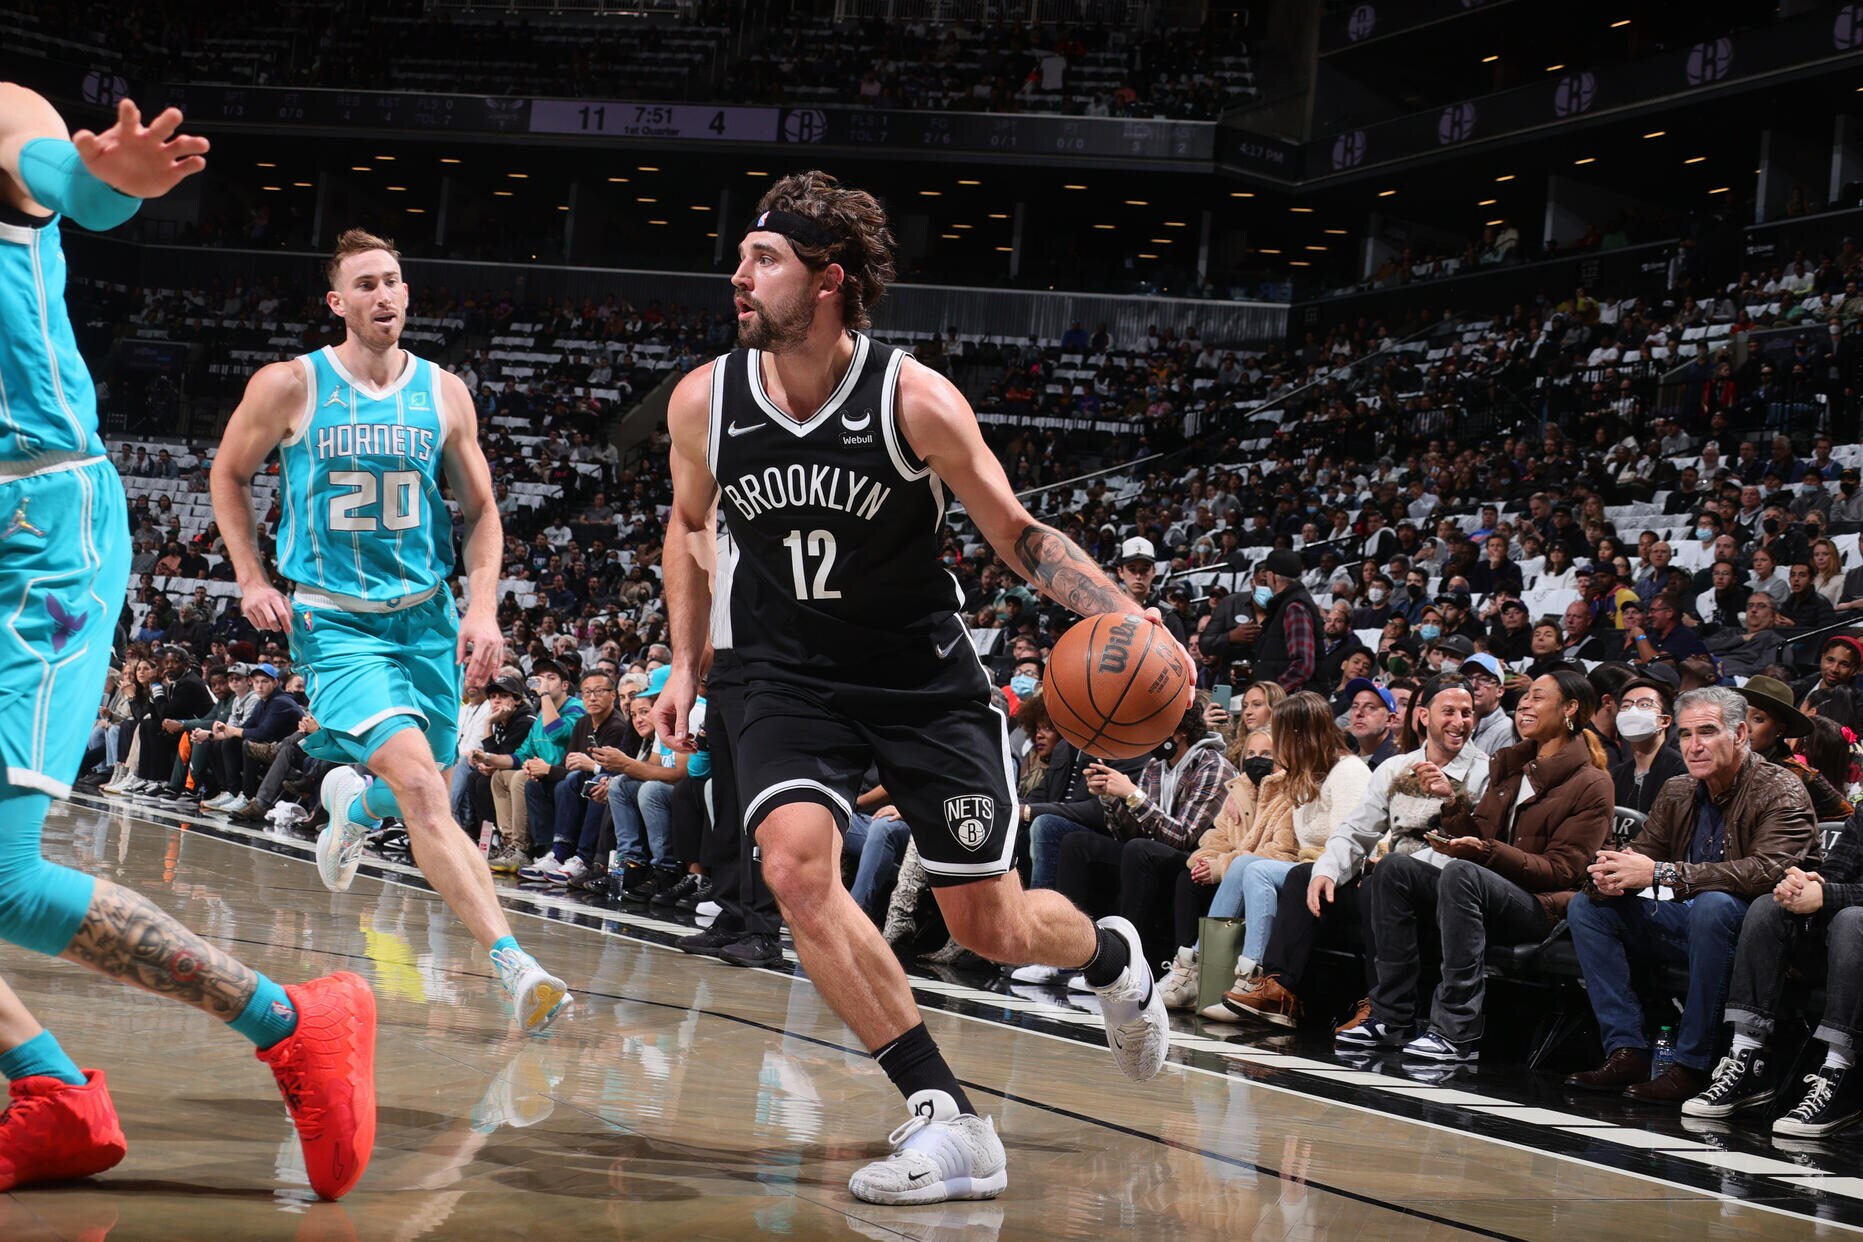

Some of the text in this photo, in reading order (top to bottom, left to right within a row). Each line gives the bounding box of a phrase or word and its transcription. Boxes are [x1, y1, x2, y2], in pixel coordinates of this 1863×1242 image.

[578, 106, 605, 130] 11
[635, 107, 673, 124] 7:51
[708, 111, 726, 135] 4
[624, 126, 680, 136] 1st Quarter
[1265, 149, 1284, 164] PM
[317, 424, 434, 461] HORNETS
[843, 434, 873, 445] Webull
[328, 470, 422, 531] 20
[724, 464, 891, 521] BROOKLYN
[783, 529, 842, 600] 12
[948, 797, 992, 822] NETS
[968, 823, 977, 843] B
